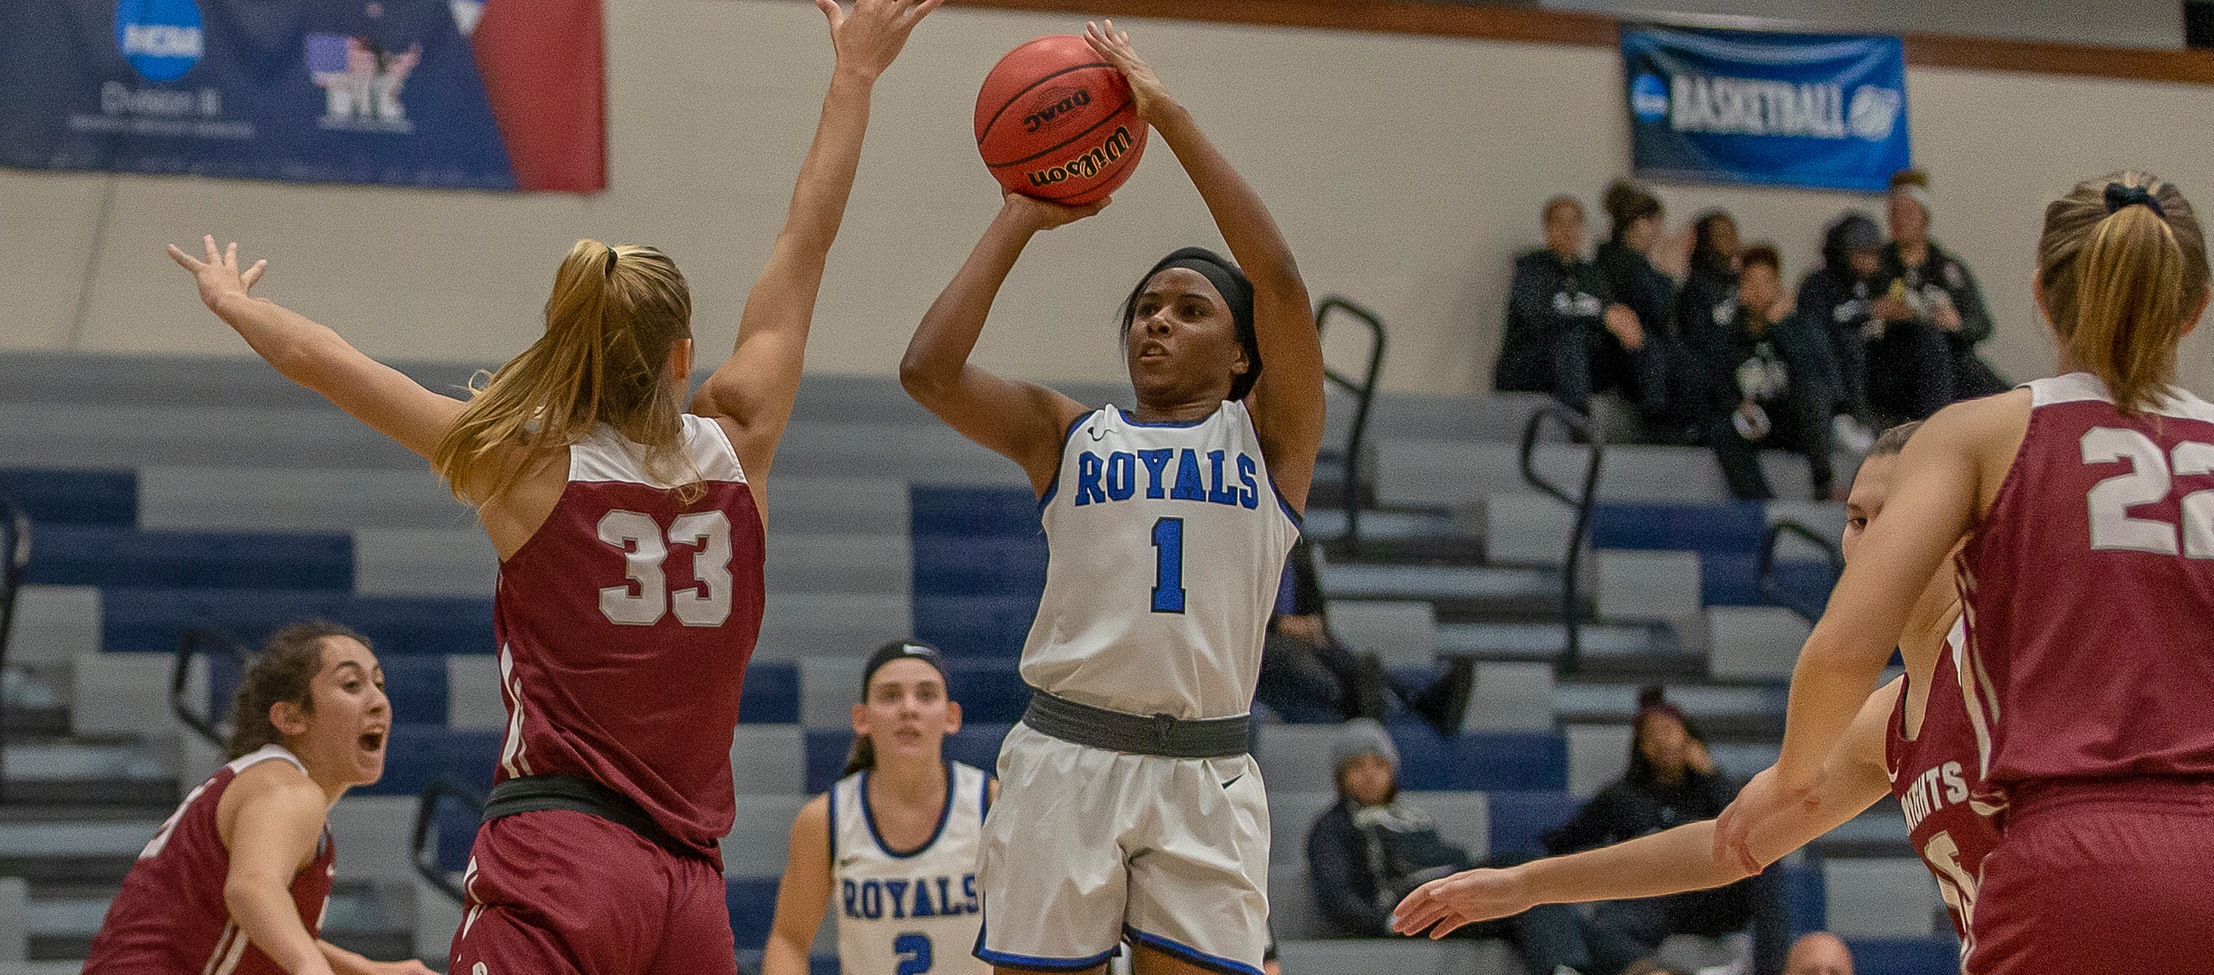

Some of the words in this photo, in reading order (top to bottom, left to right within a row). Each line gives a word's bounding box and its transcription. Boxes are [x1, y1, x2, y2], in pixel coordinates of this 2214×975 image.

[1023, 88, 1092, 133] ODAC
[1672, 73, 1846, 139] BASKETBALL
[1026, 125, 1134, 187] Wilson
[1075, 448, 1259, 510] ROYALS
[597, 509, 733, 627] 33
[1151, 517, 1186, 615] 1
[1901, 760, 1969, 836] NIGHTS
[842, 873, 980, 920] ROYALS
[893, 934, 932, 975] 2
